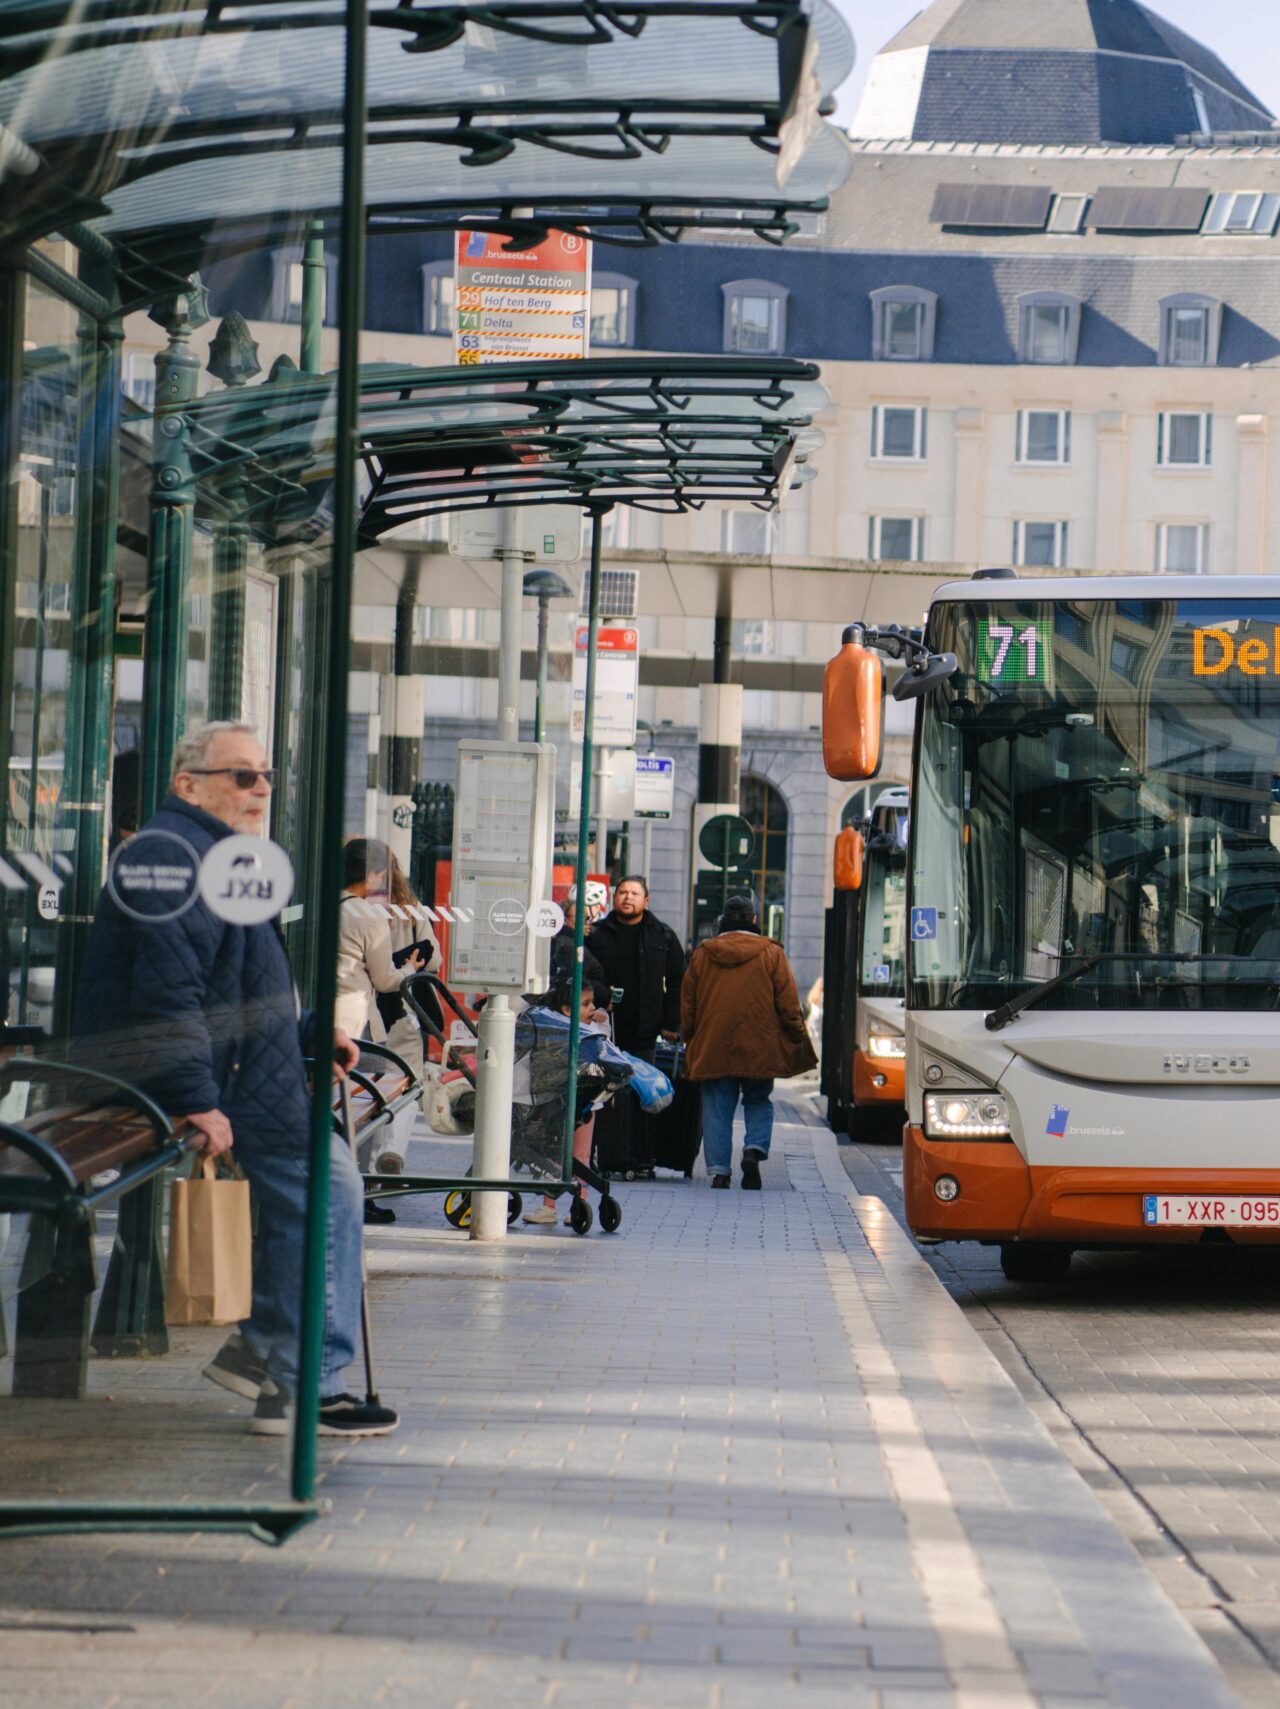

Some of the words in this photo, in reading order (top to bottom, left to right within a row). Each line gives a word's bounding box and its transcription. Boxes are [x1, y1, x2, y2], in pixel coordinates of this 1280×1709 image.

[471, 272, 525, 286] Centraal
[527, 275, 572, 288] Station
[461, 291, 481, 306] 29
[484, 296, 504, 309] Hof
[506, 297, 525, 307] ten
[527, 297, 552, 310] Berg
[460, 312, 479, 327] 71
[484, 317, 513, 329] Delta
[461, 335, 480, 348] 63
[988, 626, 1036, 676] 71
[42, 899, 61, 909] BXL
[1162, 1054, 1251, 1074] IVECO
[1147, 1211, 1156, 1221] B
[1162, 1201, 1280, 1221] 1-XXR-095
